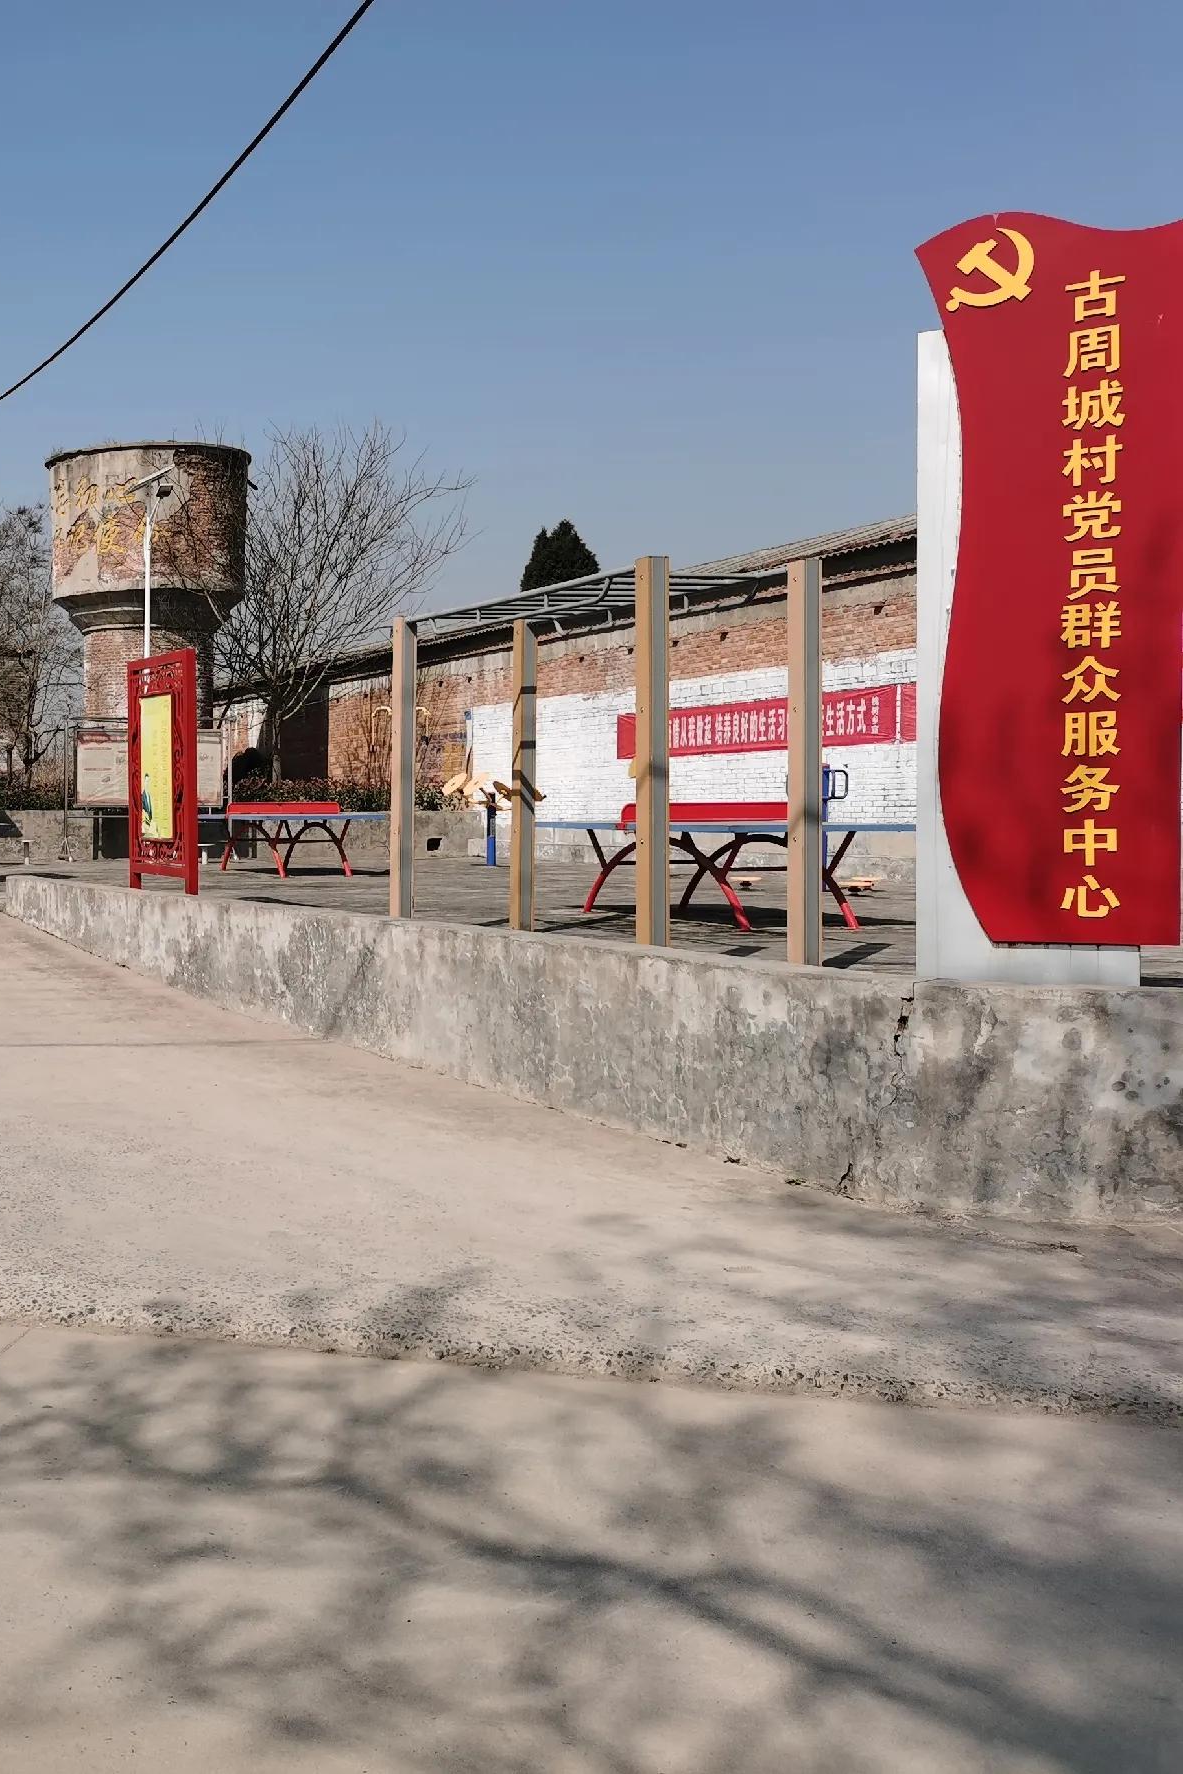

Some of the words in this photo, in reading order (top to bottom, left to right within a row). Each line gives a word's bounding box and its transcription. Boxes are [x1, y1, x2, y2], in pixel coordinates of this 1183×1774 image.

[1059, 269, 1126, 918] 古周城村党员群众服务中心
[715, 708, 788, 745] 培养良好的生活习
[822, 698, 866, 736] 生活方式
